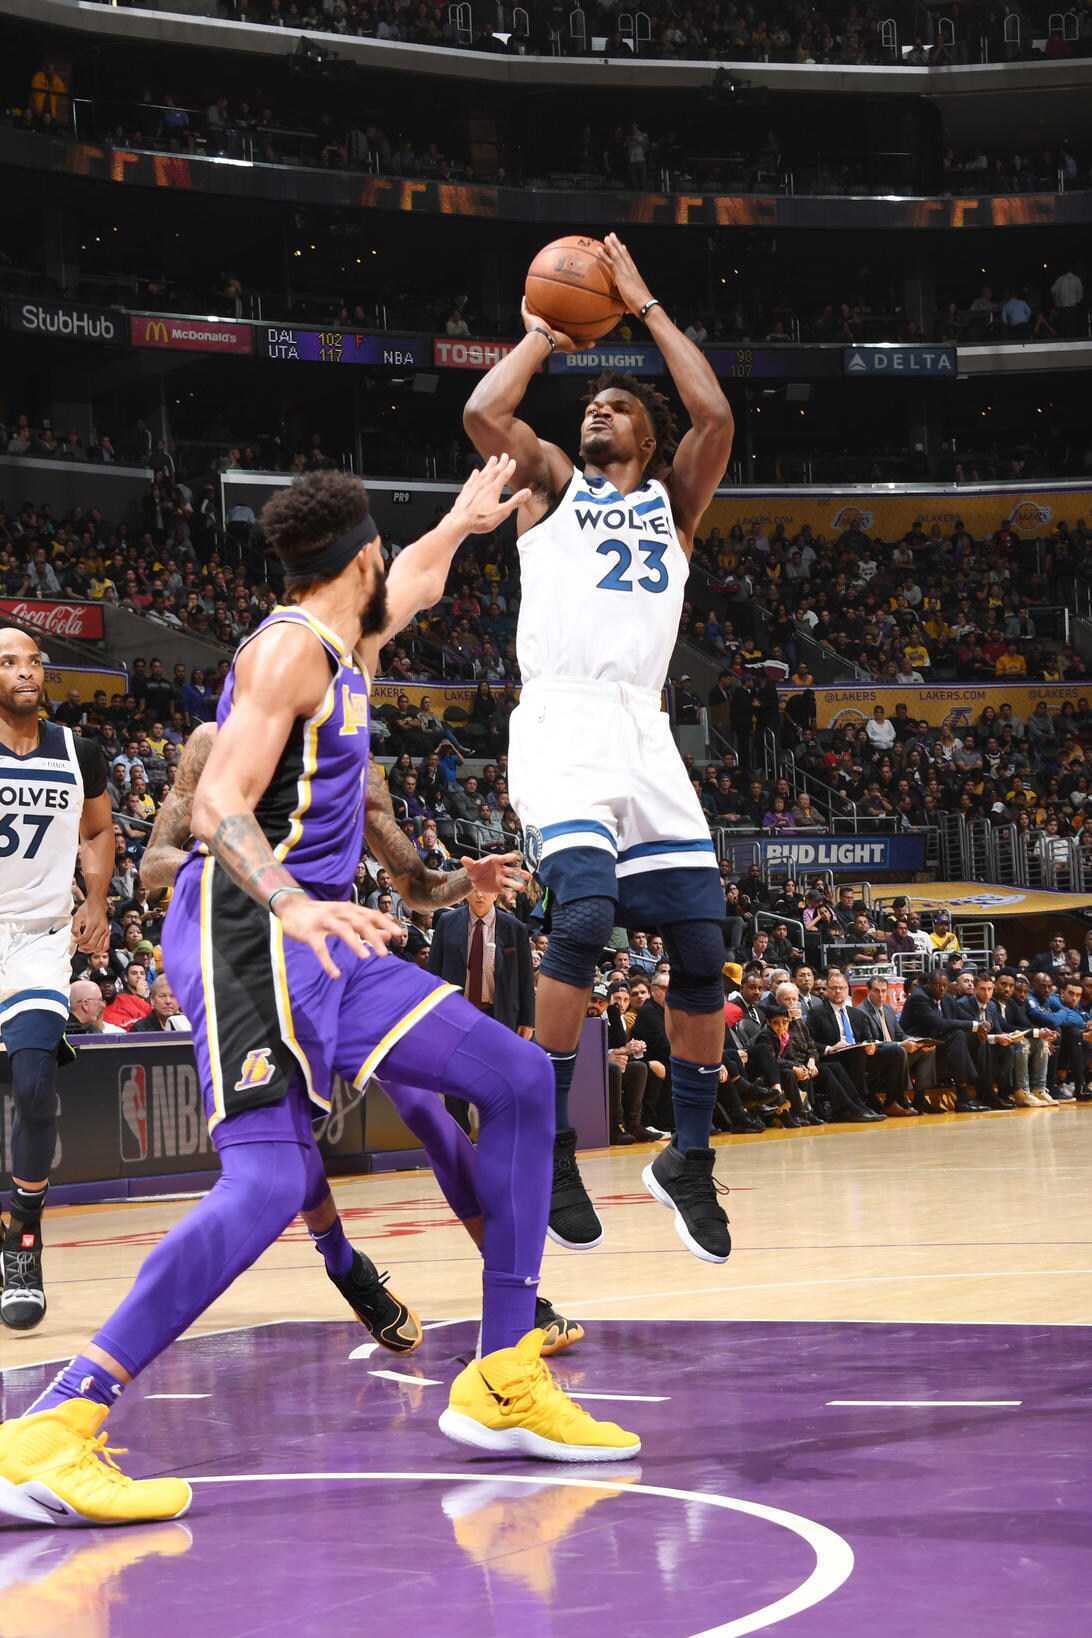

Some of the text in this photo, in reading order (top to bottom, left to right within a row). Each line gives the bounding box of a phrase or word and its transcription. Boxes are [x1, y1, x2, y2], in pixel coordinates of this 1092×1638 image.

[22, 305, 114, 338] StubHub
[171, 328, 237, 343] McDonald's
[268, 328, 364, 348] DAL 102 F
[268, 344, 343, 363] UTA 117
[383, 350, 414, 365] NBA
[566, 354, 645, 368] BUD LIGHT
[874, 353, 951, 369] DELTA
[393, 492, 410, 503] PR9
[575, 508, 673, 540] WOLE
[596, 538, 669, 594] 23
[919, 690, 986, 701] LAKERS.COM
[47, 761, 66, 769] fitbit
[0, 786, 69, 810] OLVES
[0, 813, 55, 860] 67
[766, 843, 885, 864] BUD LIGHT
